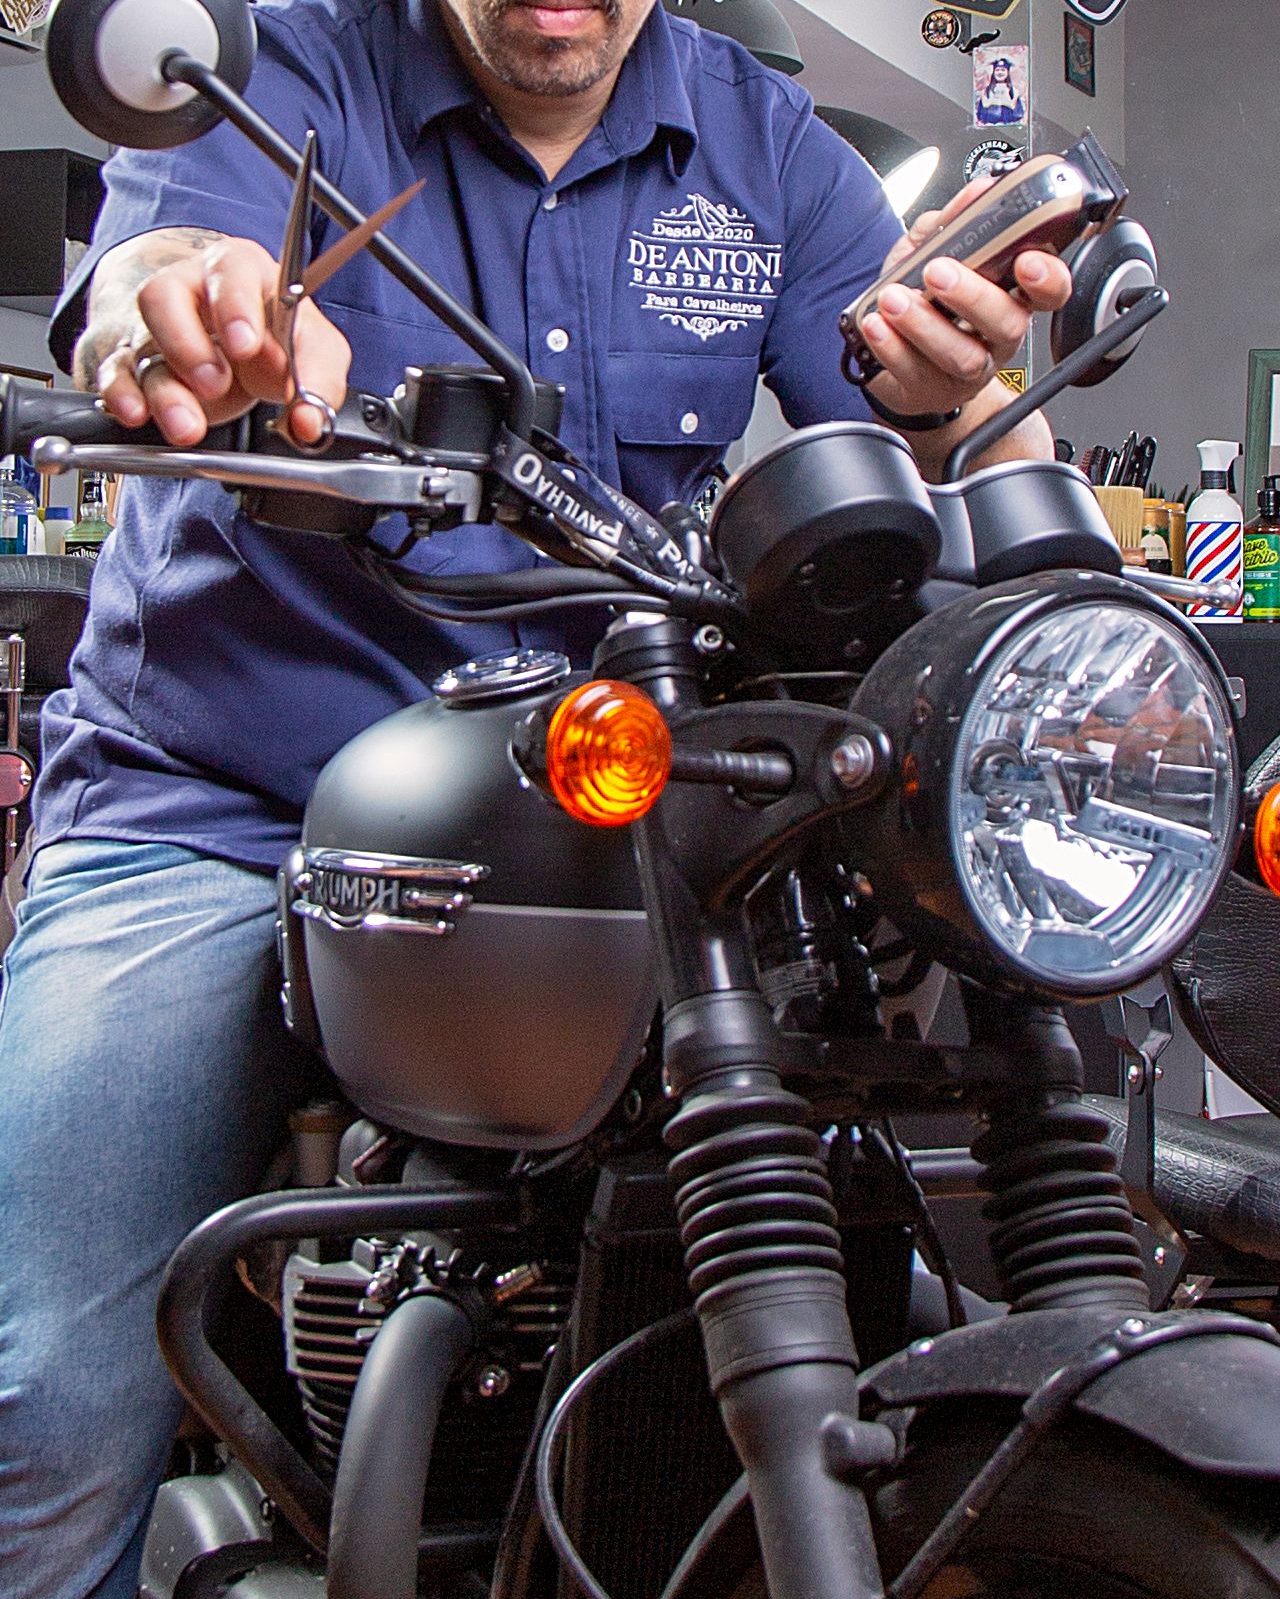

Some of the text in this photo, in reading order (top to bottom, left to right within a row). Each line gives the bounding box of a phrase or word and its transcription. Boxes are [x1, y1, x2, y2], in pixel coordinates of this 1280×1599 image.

[966, 140, 1008, 174] KNUCKLEHEAD
[652, 222, 753, 241] Desde 2020
[628, 238, 782, 277] DE ANTONI
[633, 268, 774, 293] BARBEARIA
[646, 293, 763, 314] Para Cavalheiros
